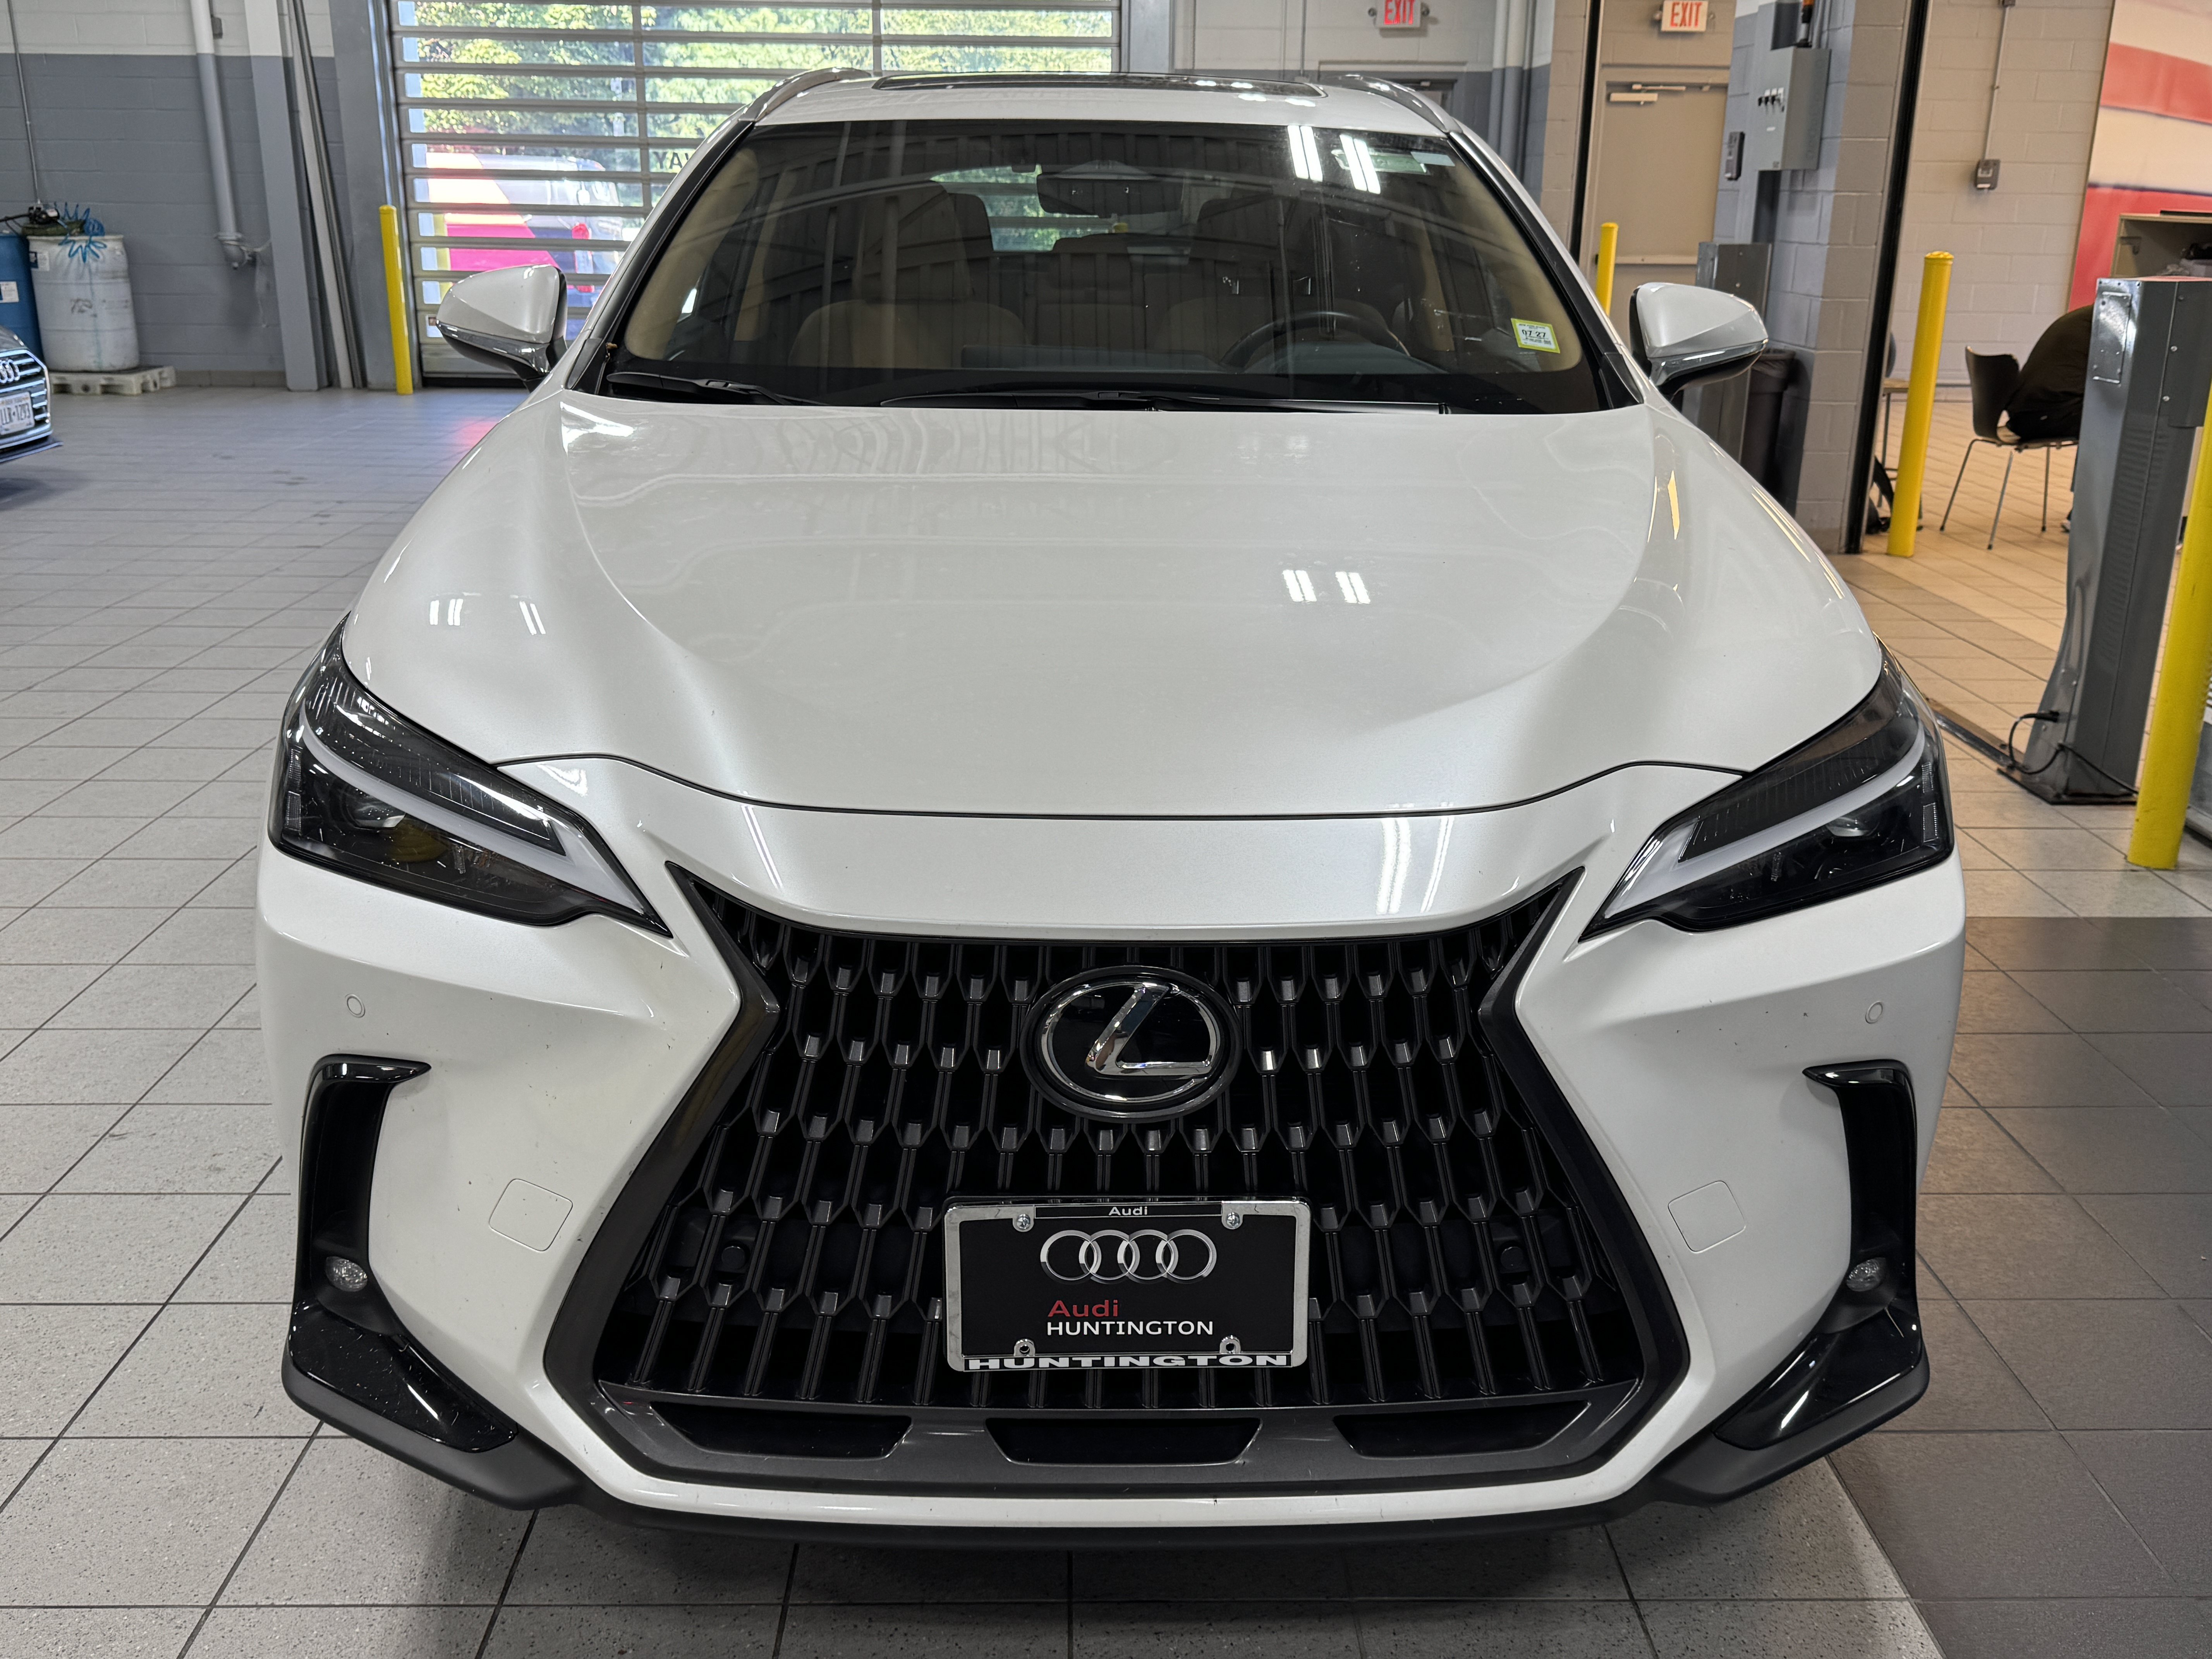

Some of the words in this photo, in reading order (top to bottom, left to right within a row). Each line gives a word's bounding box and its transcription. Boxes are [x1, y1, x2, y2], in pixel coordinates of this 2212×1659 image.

[1384, 0, 1415, 25] EXIT
[1670, 2, 1702, 27] EXIT
[1109, 1206, 1148, 1216] Audi
[1048, 1300, 1118, 1317] Audi
[1048, 1321, 1213, 1336] HUNTINGTON
[969, 1355, 1287, 1370] HUNTINGTON
